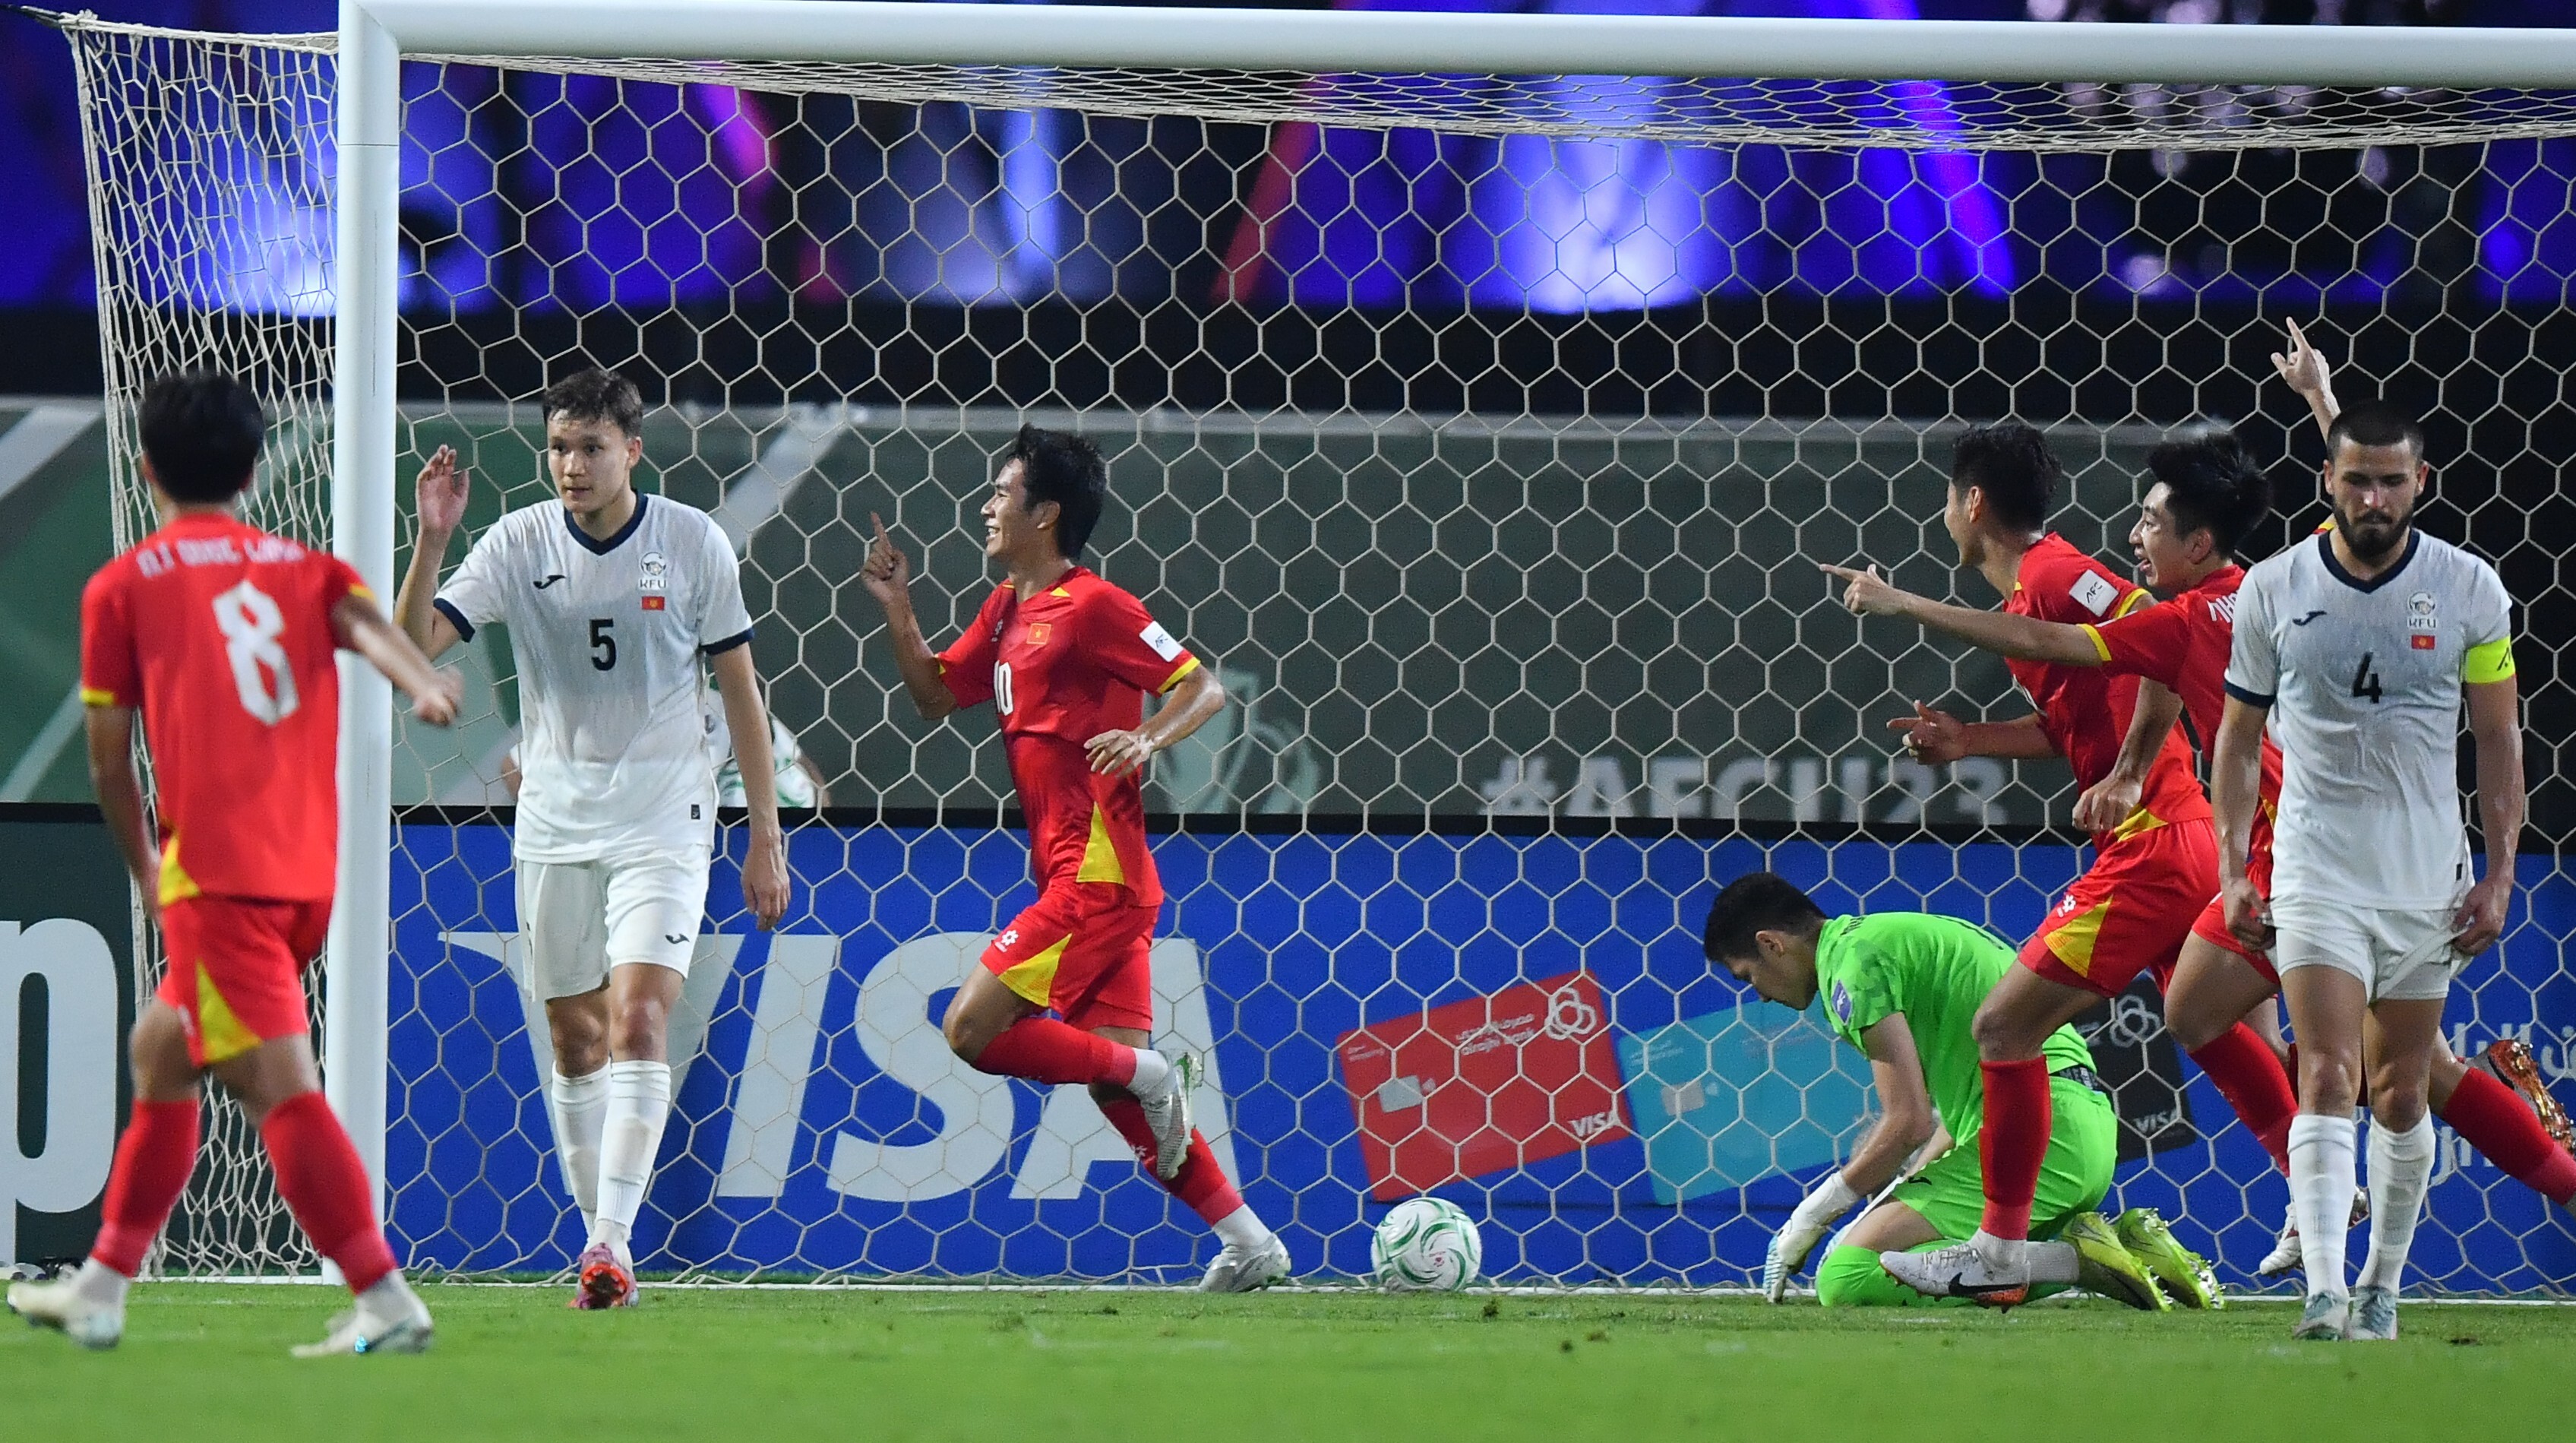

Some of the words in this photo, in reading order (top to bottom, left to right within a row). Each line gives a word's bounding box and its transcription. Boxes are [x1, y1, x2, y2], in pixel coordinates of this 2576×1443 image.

[640, 579, 666, 588] KFU
[589, 619, 616, 671] 5
[2409, 618, 2436, 628] KFU
[212, 578, 299, 726] 8
[2353, 651, 2382, 704] 4
